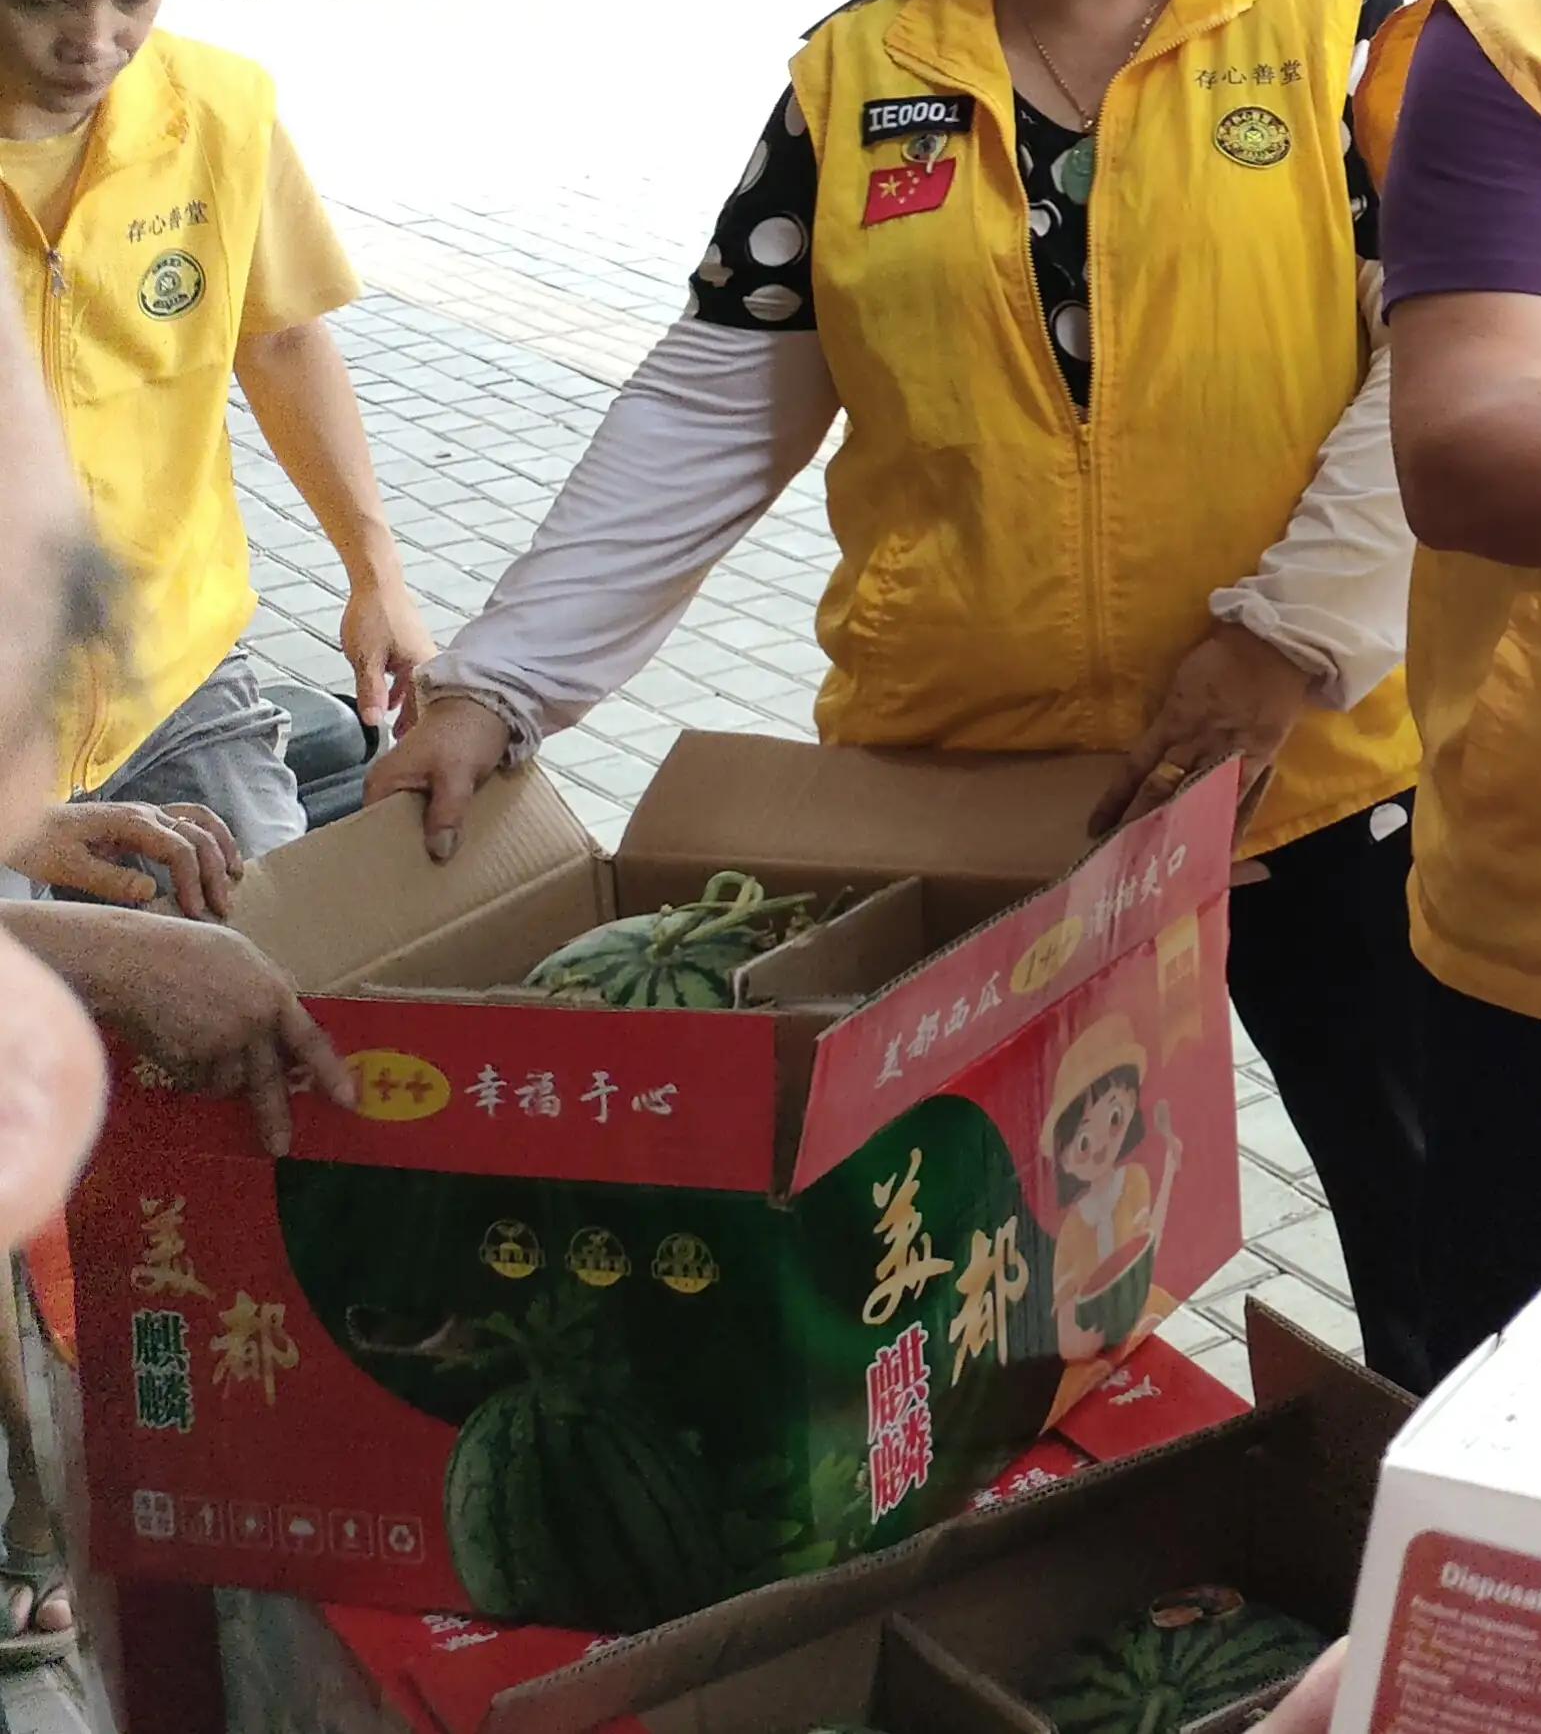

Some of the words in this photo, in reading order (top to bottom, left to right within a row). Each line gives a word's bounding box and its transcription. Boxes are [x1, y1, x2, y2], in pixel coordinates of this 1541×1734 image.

[1194, 59, 1304, 90] 存心善堂
[868, 101, 960, 132] IE0001
[126, 198, 209, 244] 存心善堂
